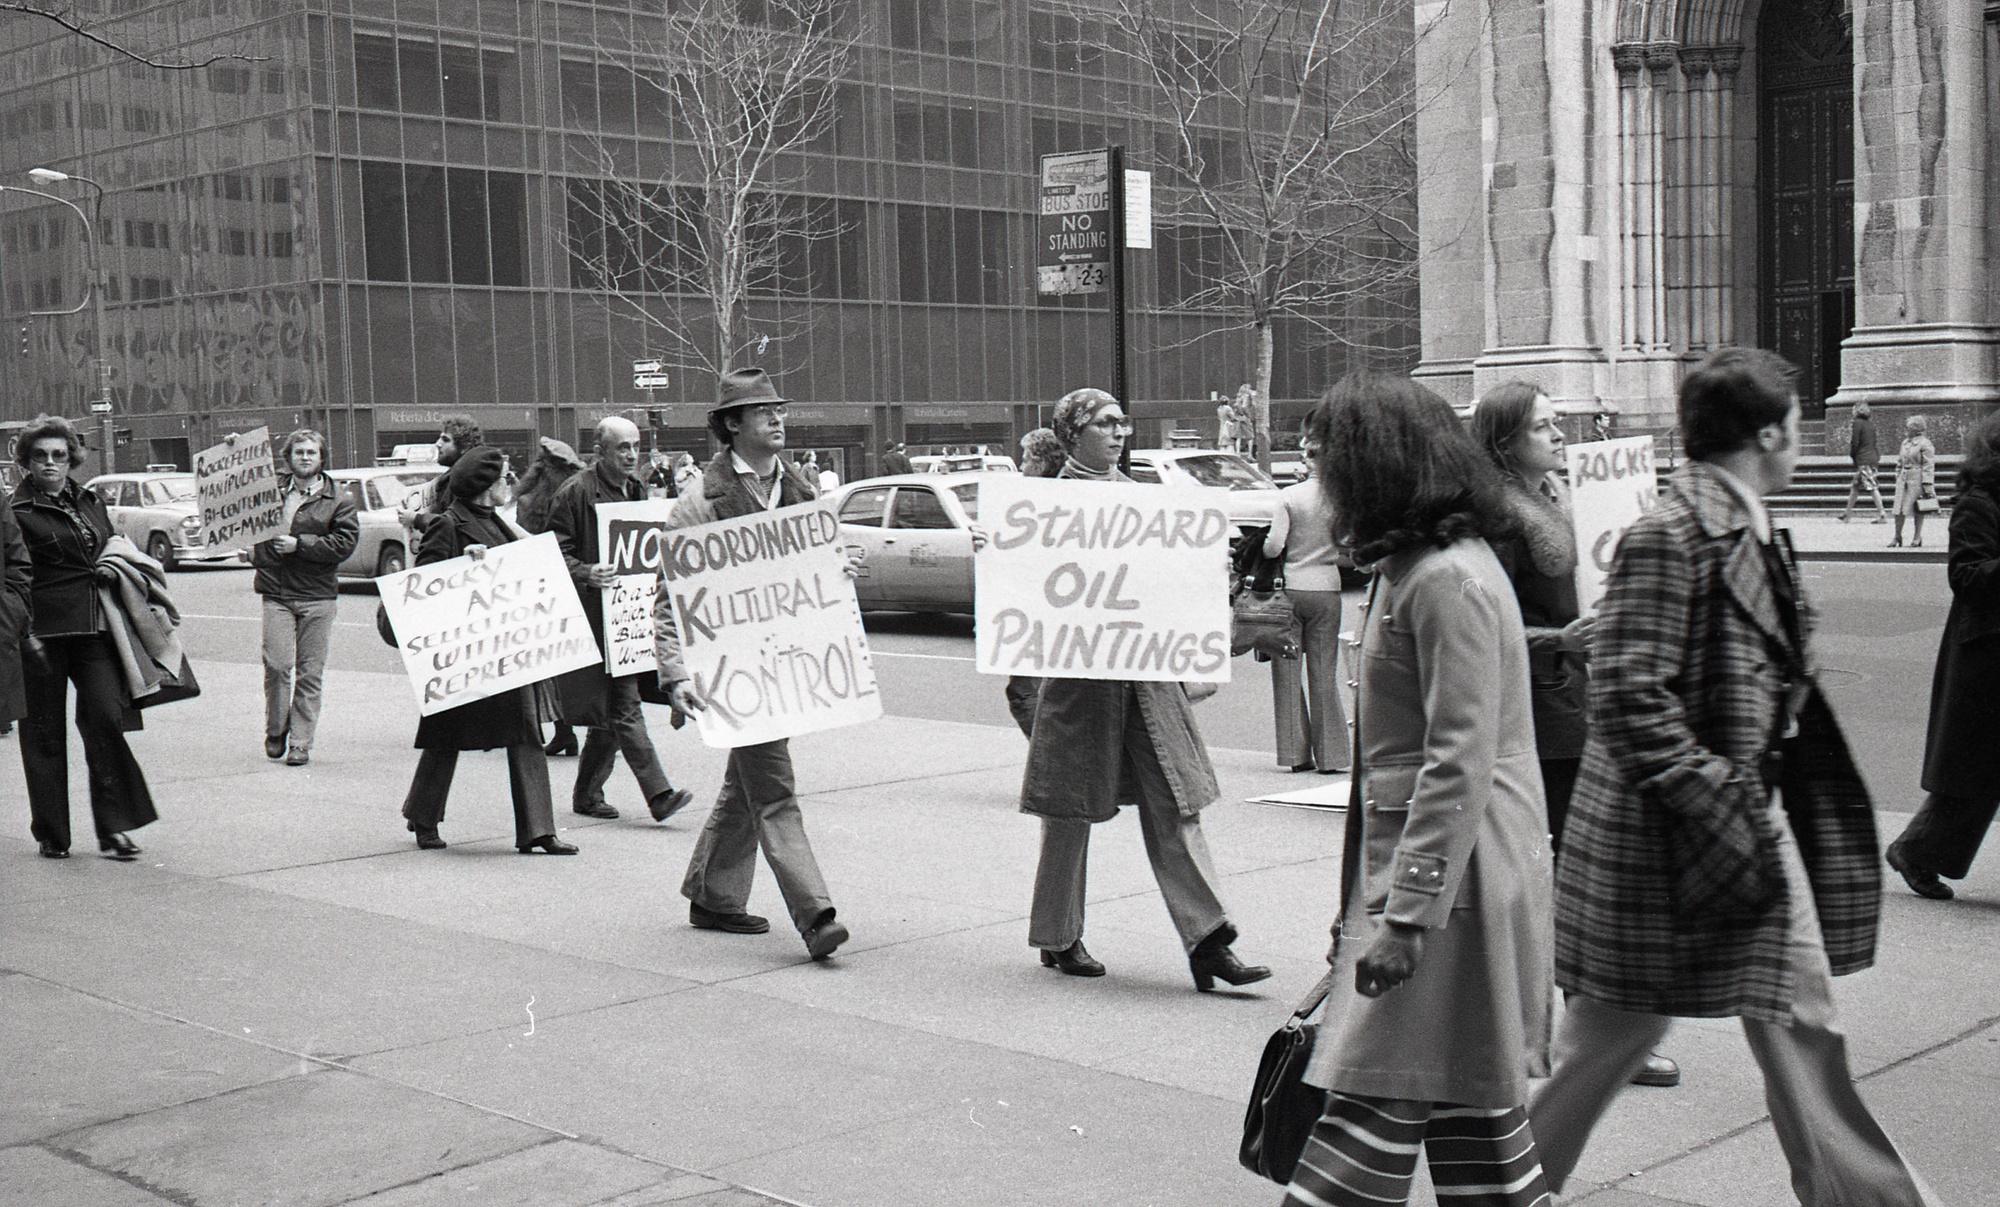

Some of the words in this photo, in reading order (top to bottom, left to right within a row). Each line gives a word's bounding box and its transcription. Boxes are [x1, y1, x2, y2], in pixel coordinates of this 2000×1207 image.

[1045, 196, 1070, 212] BUS
[1076, 192, 1110, 210] STOP
[1062, 214, 1092, 232] NO
[1049, 231, 1107, 251] STANDING
[196, 439, 271, 478] ROCKEFELLER
[207, 506, 284, 548] ART-MARKET
[659, 509, 838, 582] KOORDINATED
[993, 500, 1228, 550] STANDARD
[399, 557, 504, 606] ROCKY
[466, 577, 546, 616] ART:
[612, 581, 627, 605] to
[1043, 561, 1141, 610] OIL
[675, 573, 842, 647] KULTURAL
[432, 614, 584, 671] WITHOUT
[989, 607, 1226, 676] PAINTINGS
[693, 635, 876, 730] KONTROL
